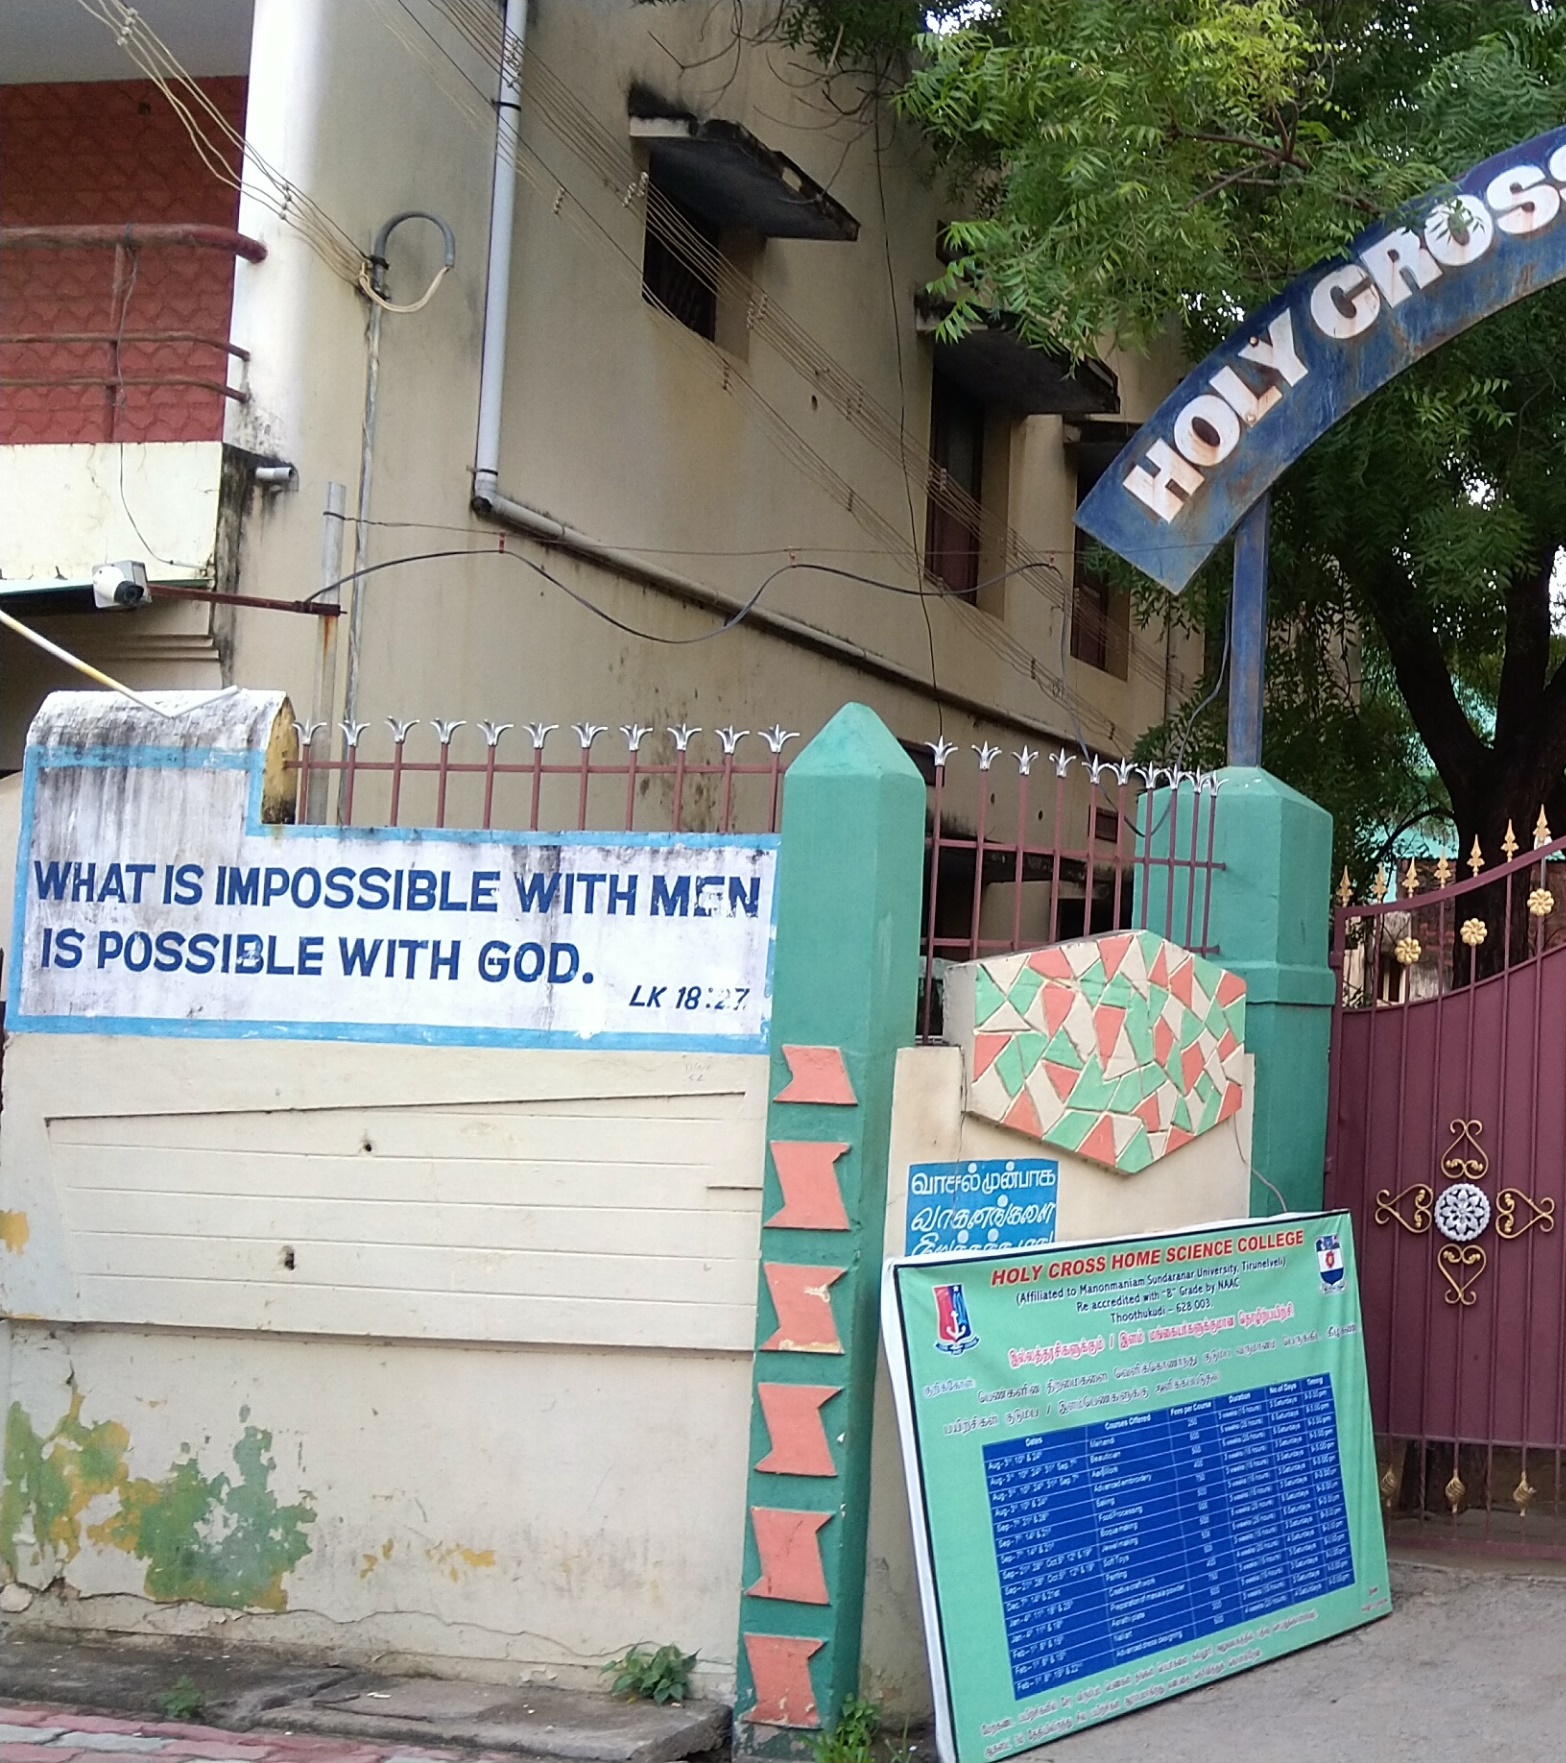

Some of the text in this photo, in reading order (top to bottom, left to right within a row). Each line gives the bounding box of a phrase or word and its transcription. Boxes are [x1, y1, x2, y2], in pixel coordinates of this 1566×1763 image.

[1122, 308, 1311, 524] HOLY
[34, 860, 760, 919] WHAT IS IMPOSSIBLE WITH MEN
[42, 928, 594, 985] IS POSSIBLE WITH GOD.
[628, 984, 668, 1009] LK
[990, 1230, 1304, 1285] HOLY CROSS HOME SCIENCE COLLEGE
[1066, 1287, 1076, 1296] to
[1079, 1276, 1144, 1294] Manonmaniam
[1147, 1269, 1195, 1284] Sundaranar
[1091, 1293, 1140, 1309] accredited
[1142, 1290, 1159, 1301] with
[1178, 1283, 1203, 1295] Grade
[1205, 1281, 1215, 1293] by
[1217, 1277, 1239, 1289] NAAC
[1110, 1305, 1165, 1323] Thoothukudi
[1176, 1301, 1192, 1312] 628
